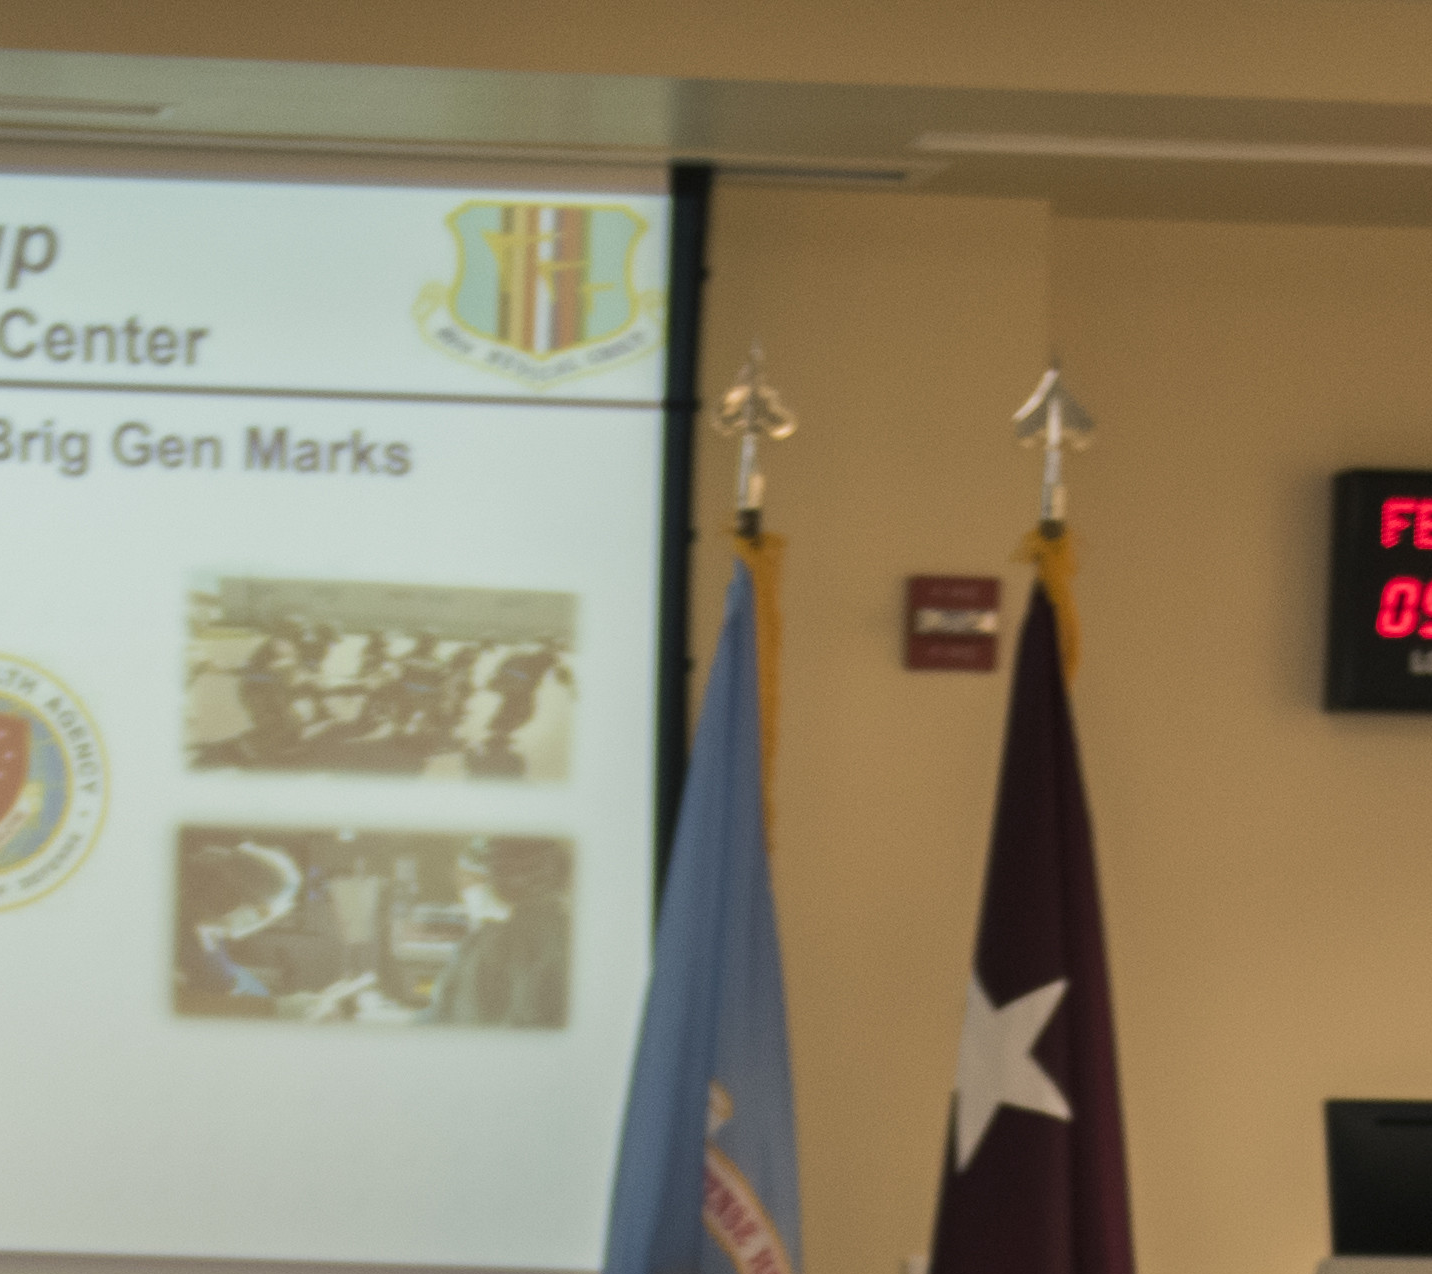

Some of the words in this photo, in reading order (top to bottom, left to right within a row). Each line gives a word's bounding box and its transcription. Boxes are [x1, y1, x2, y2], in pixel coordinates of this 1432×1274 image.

[110, 420, 226, 471] Gen
[243, 426, 413, 478] Marks
[44, 696, 99, 794] AGENCY
